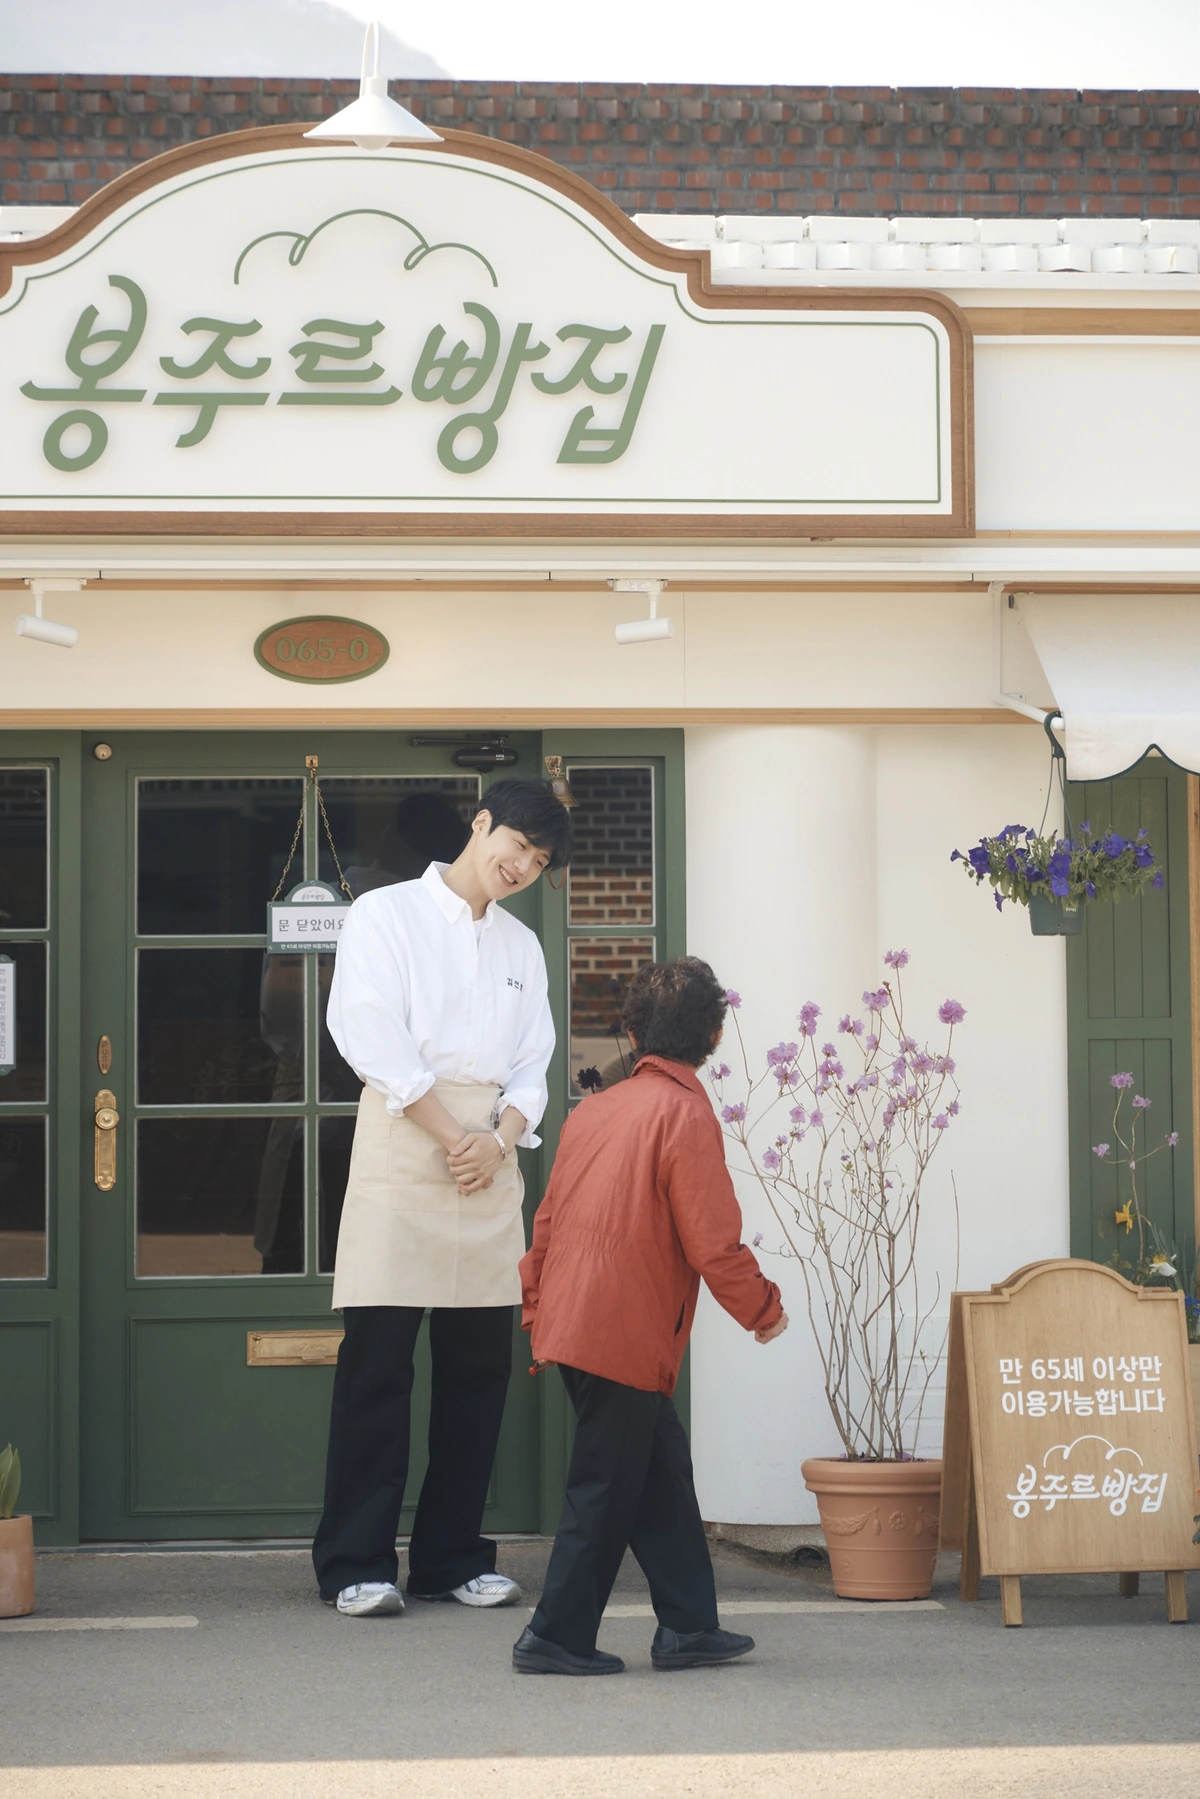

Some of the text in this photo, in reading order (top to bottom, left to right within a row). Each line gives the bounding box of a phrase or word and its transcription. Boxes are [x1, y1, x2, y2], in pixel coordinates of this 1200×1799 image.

[19, 274, 667, 475] 봉주르빵집
[276, 637, 370, 663] 065-0
[279, 919, 290, 932] 문
[999, 1355, 1163, 1385] 만 65세 이상만
[1001, 1387, 1166, 1418] 이용가능합니다
[1006, 1464, 1168, 1519] 봉주르빵집
